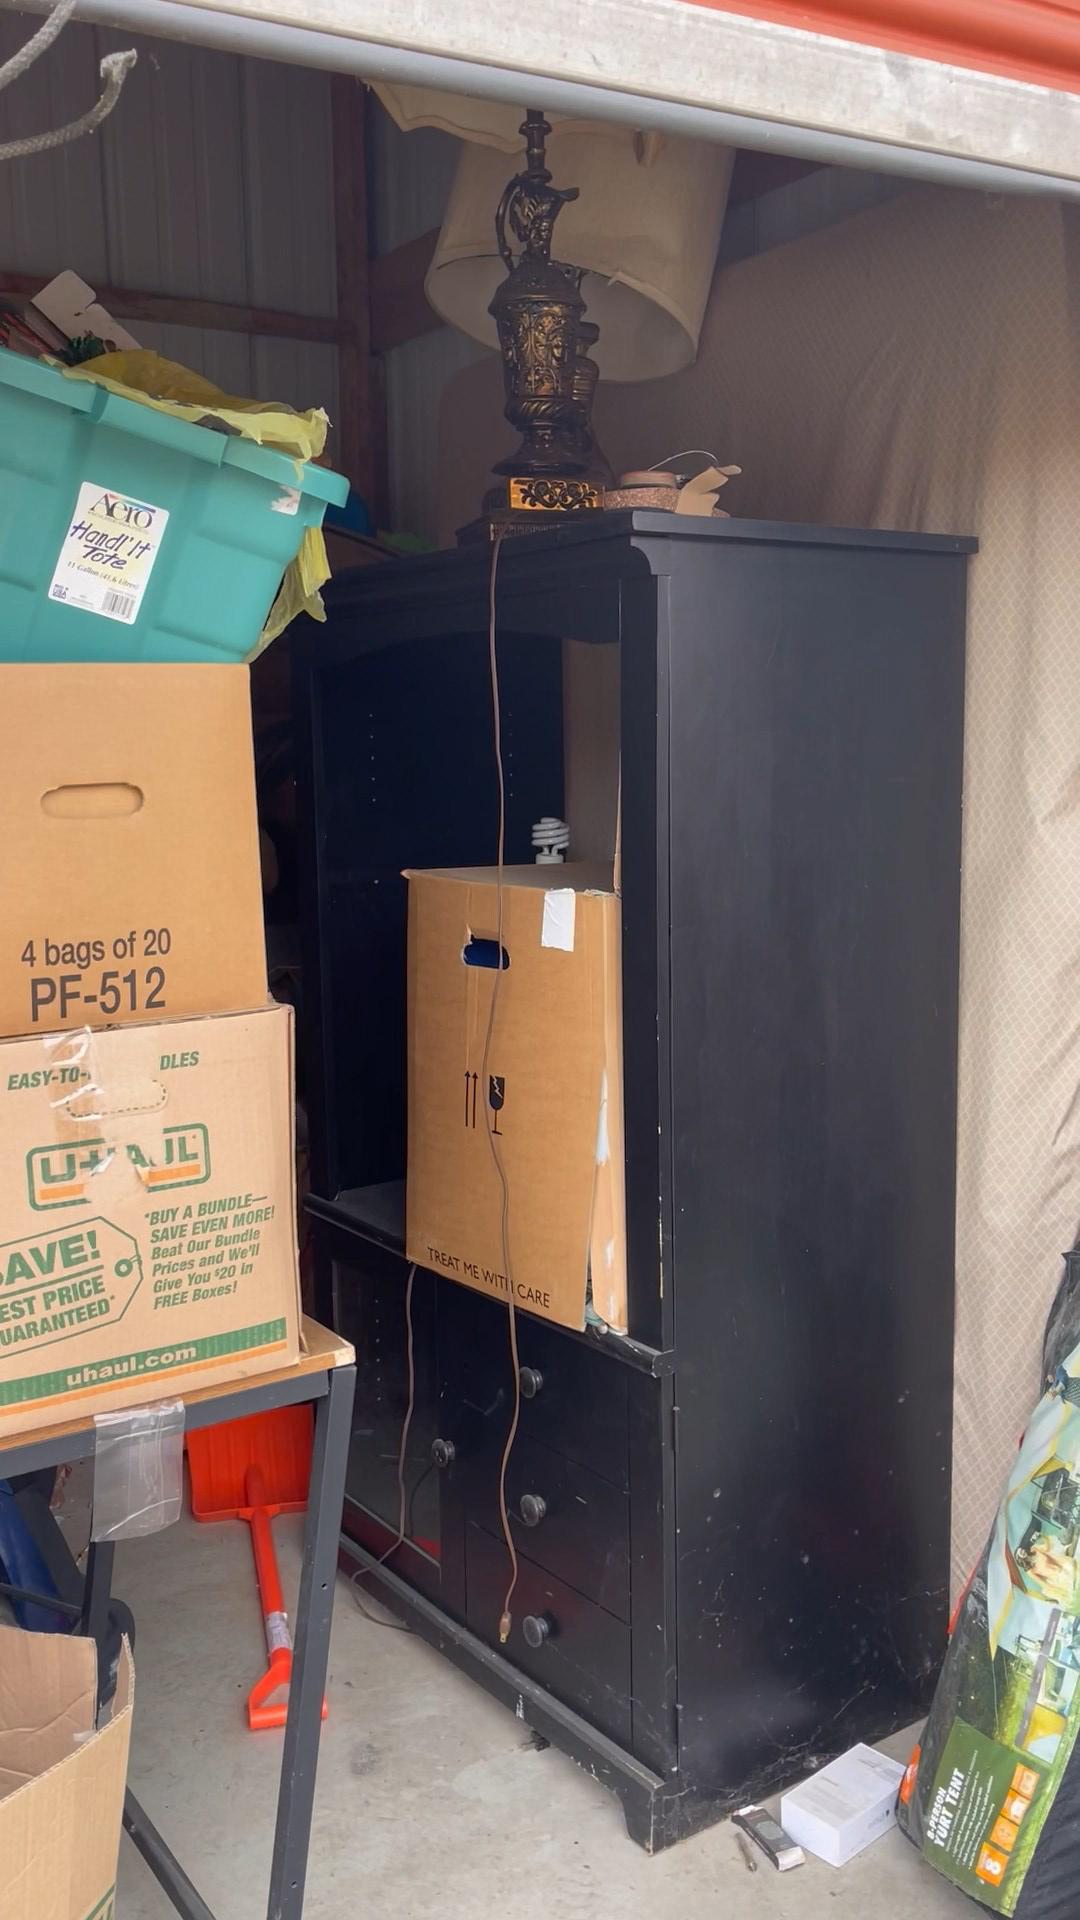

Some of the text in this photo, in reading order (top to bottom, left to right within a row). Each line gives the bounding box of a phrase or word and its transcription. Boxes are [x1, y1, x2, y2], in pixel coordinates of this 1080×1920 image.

[90, 493, 153, 529] Aero
[83, 544, 127, 570] Tote
[127, 540, 151, 559] It
[77, 563, 99, 576] Gallon
[21, 928, 171, 969] 4 bags of 20
[31, 966, 167, 1022] PF-512
[7, 1066, 91, 1091] EASY-TO-
[150, 1205, 275, 1244] SAVE EVEN MORE!
[183, 1205, 193, 1220] A
[0, 1230, 101, 1287] AVE!
[151, 1228, 261, 1261] Beat Our Bundle
[152, 1243, 261, 1278] Prices and We'll
[43, 1274, 106, 1312] PRICE
[153, 1263, 254, 1294] Give You $20 in
[428, 1246, 551, 1308] TREAT ME WITH CARE
[153, 1280, 238, 1310] FREE Boxes!
[66, 1346, 198, 1387] uhaul.com
[933, 1807, 954, 1848] YURT
[945, 1767, 966, 1806] TENT
[984, 1857, 1001, 1876] 8
